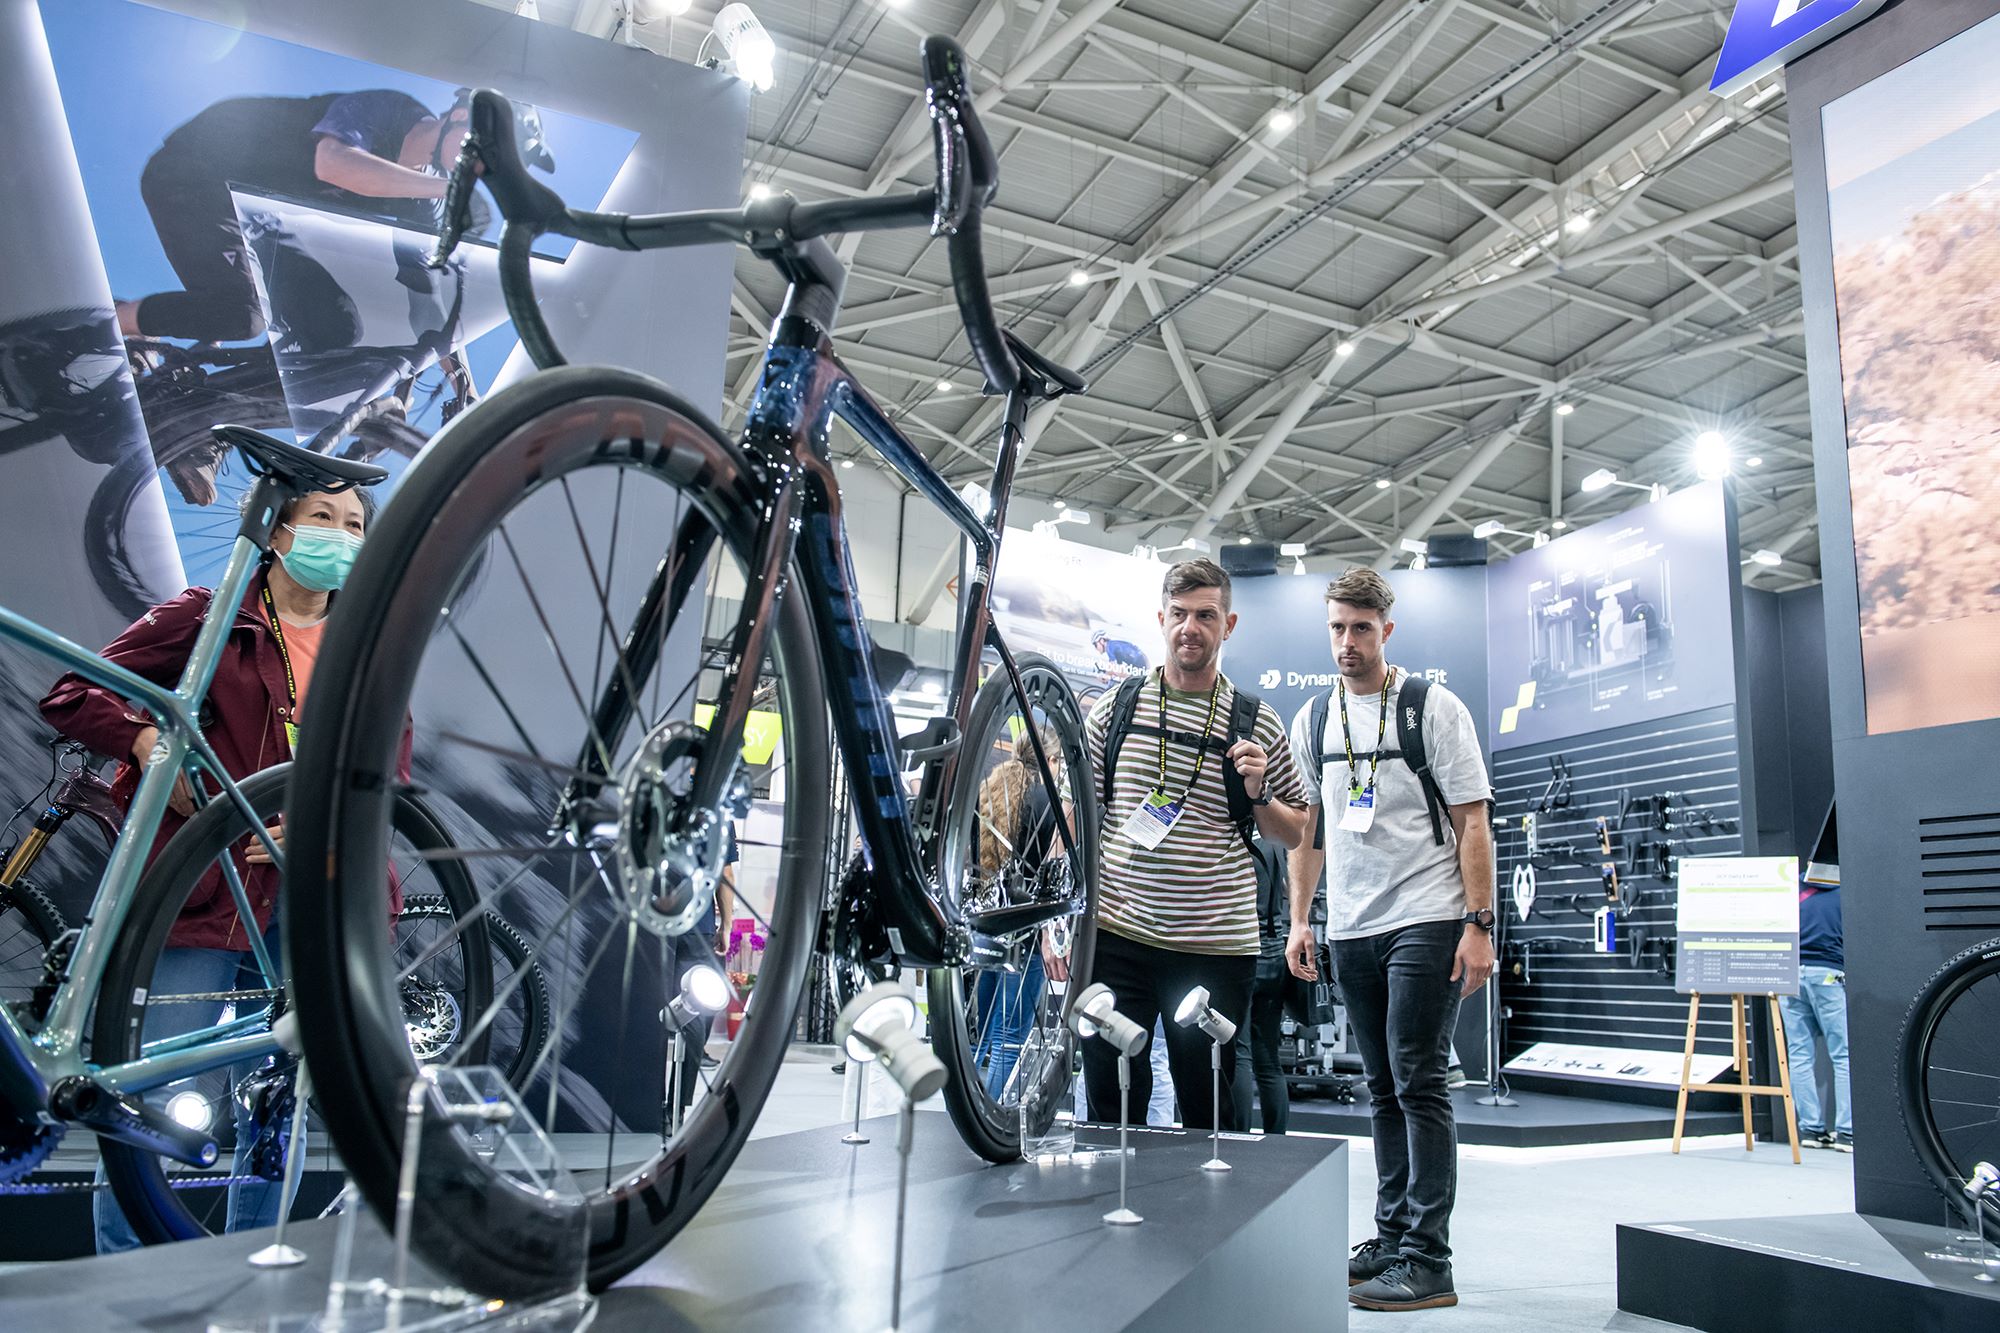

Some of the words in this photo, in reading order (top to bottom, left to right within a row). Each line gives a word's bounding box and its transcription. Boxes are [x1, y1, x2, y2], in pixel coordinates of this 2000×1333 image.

[1098, 659, 1151, 677] boundarie
[1286, 671, 1341, 690] Dynam
[1425, 668, 1448, 685] Fit
[744, 727, 768, 747] SY
